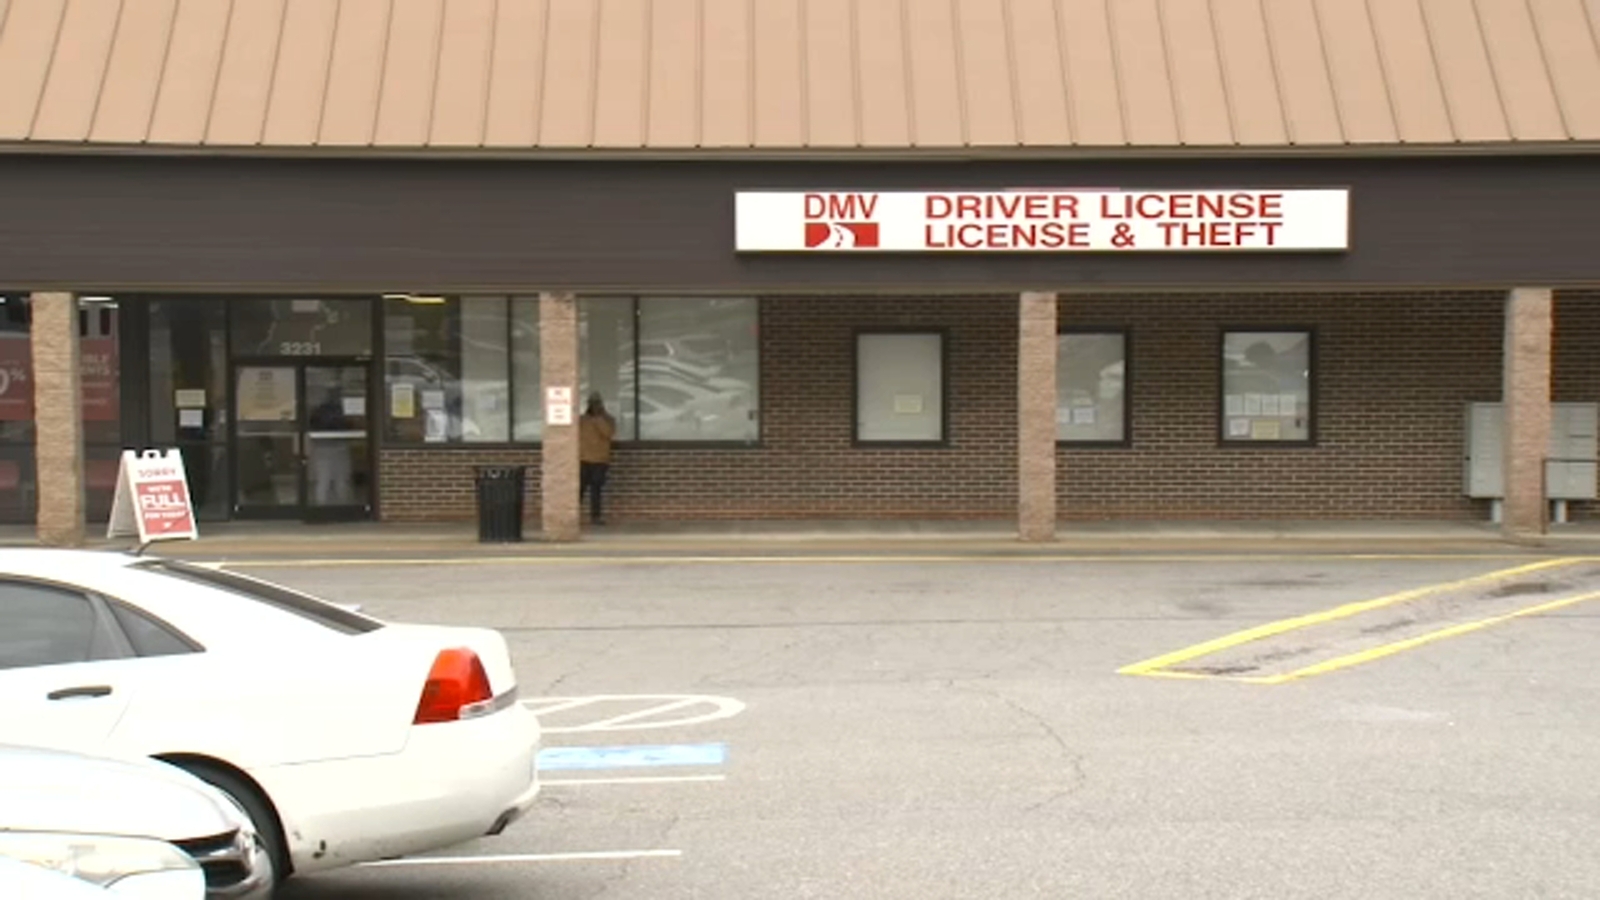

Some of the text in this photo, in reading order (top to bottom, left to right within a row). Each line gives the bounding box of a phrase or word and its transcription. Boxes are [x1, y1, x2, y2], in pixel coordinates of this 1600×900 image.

[804, 194, 879, 220] DMV
[925, 194, 1282, 219] DRIVER LICENSE
[925, 223, 1281, 249] LICENSE & THEFT
[280, 341, 321, 355] 3231
[141, 493, 186, 510] FULL
